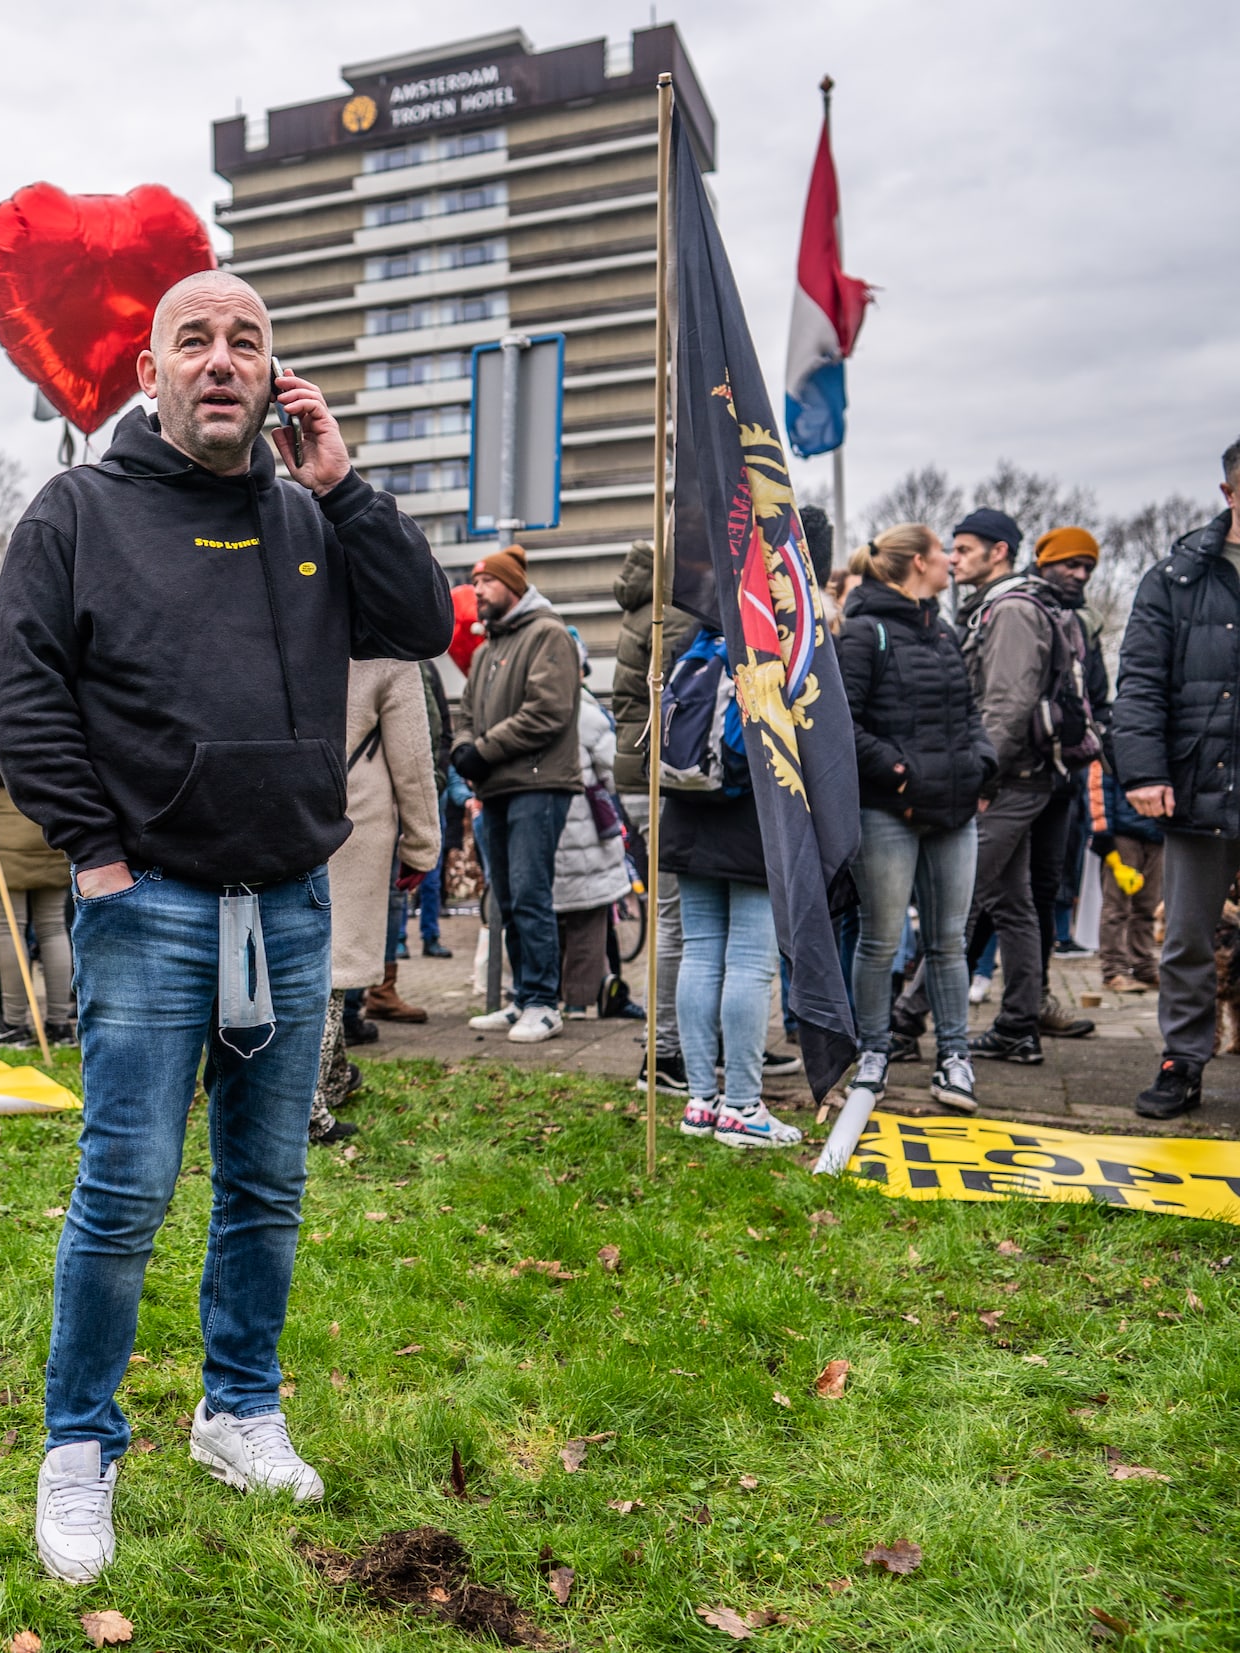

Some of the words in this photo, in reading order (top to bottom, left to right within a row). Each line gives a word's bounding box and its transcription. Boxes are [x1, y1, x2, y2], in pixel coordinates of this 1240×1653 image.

[390, 66, 499, 103] AMSTERDAM
[391, 98, 457, 127] TROPEN
[461, 86, 516, 112] HOTEL
